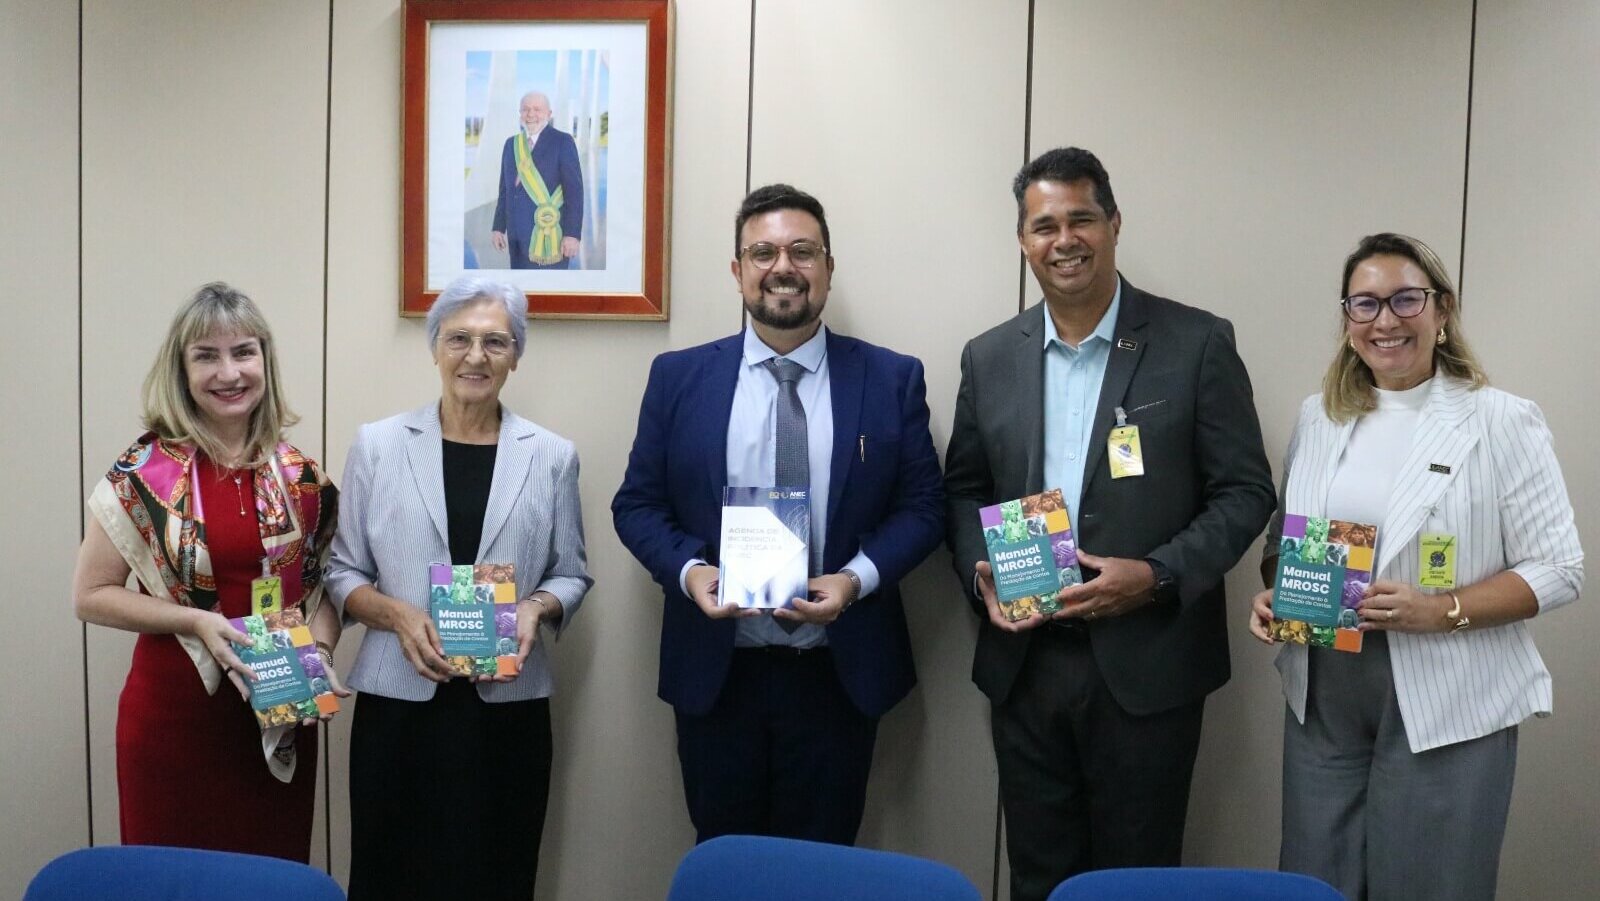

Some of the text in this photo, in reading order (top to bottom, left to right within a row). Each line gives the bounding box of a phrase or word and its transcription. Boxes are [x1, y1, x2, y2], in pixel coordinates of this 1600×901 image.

[995, 544, 1040, 561] Manual
[997, 556, 1043, 573] MROSC
[1283, 565, 1331, 582] Manual
[1281, 578, 1330, 594] MROSC
[1279, 596, 1304, 605] Prestação
[1287, 591, 1323, 602] Planejamento
[438, 609, 484, 618] Manual
[439, 620, 484, 629] MROSC
